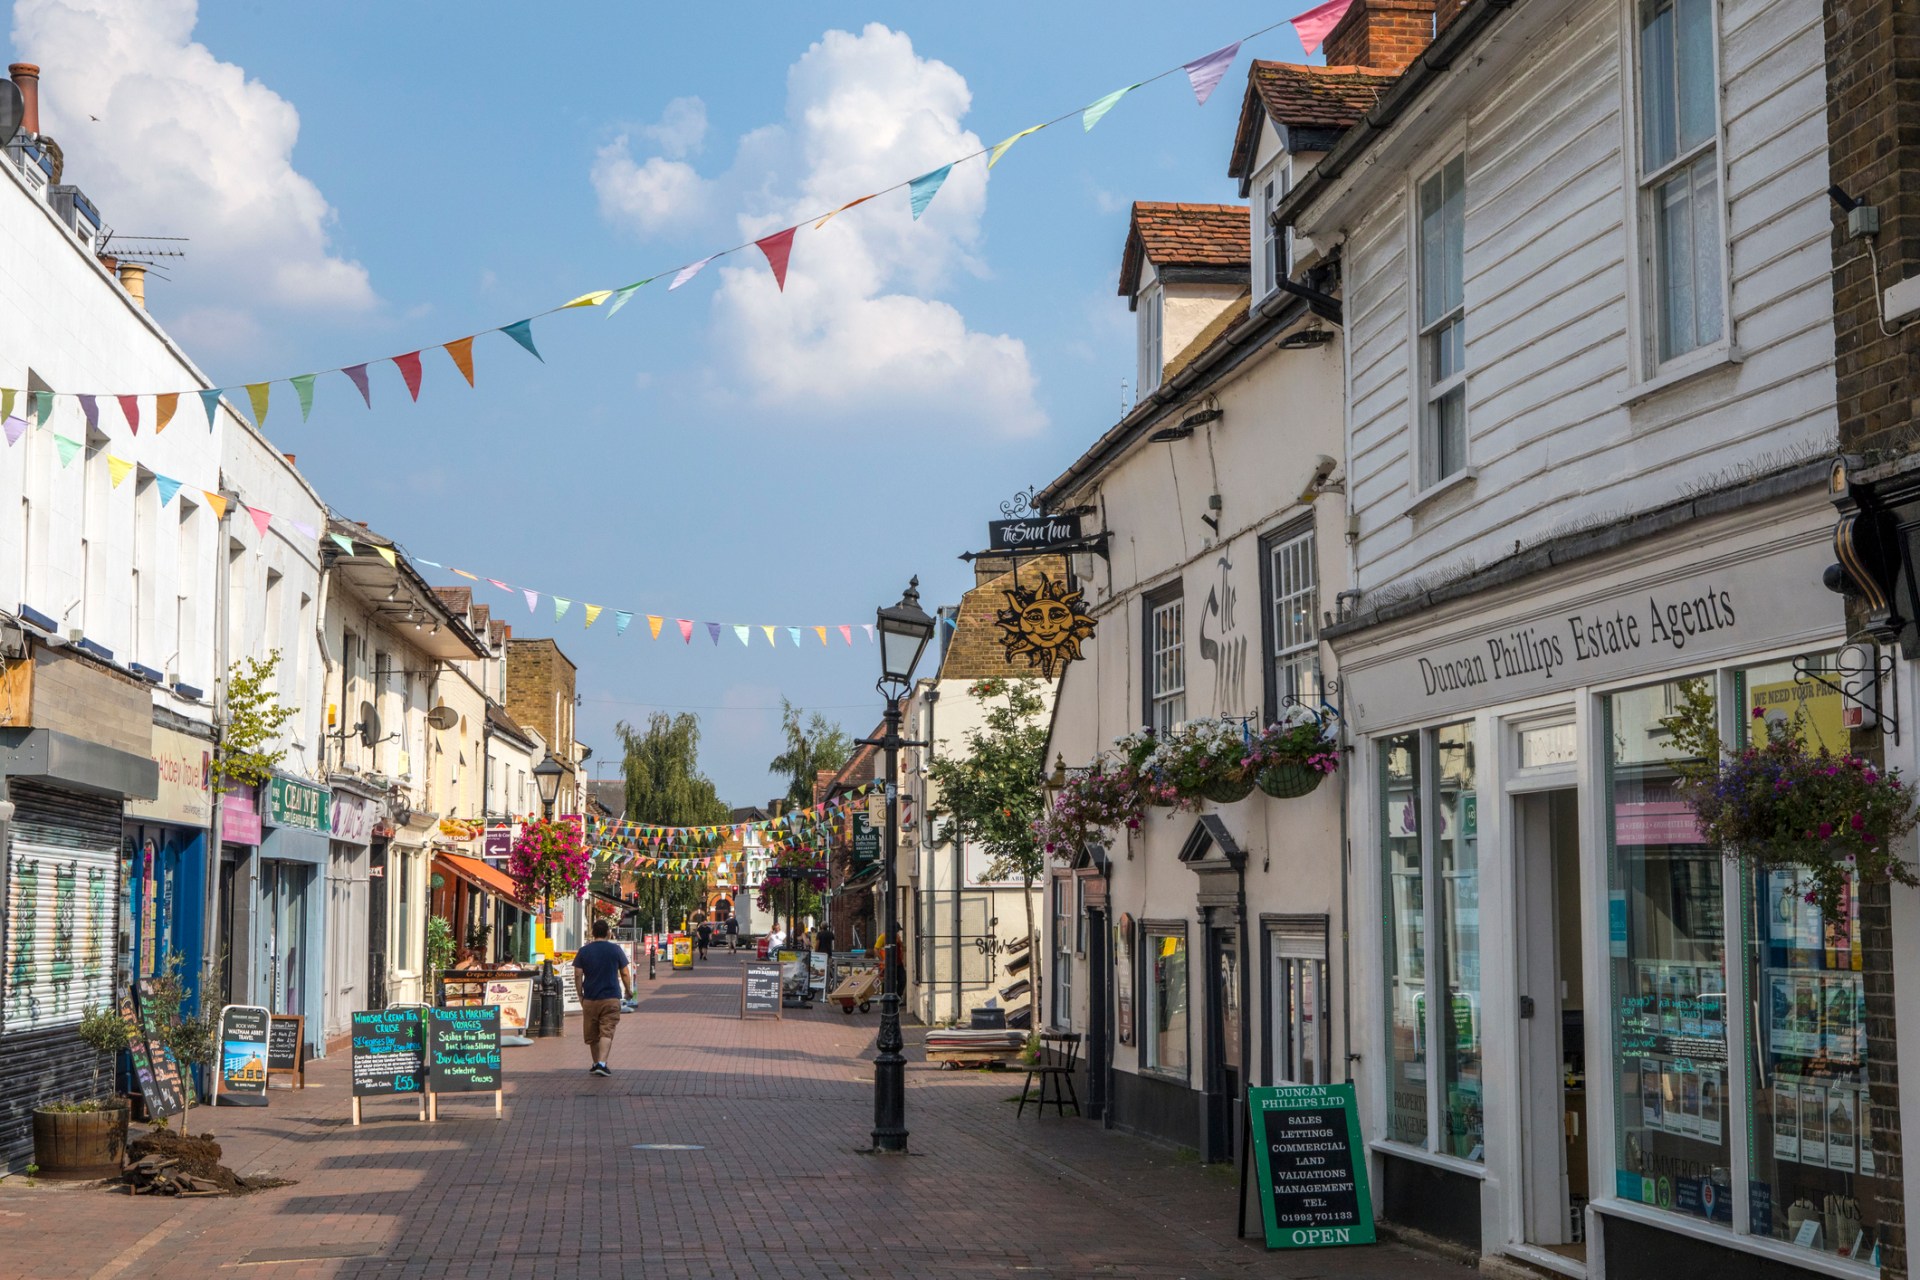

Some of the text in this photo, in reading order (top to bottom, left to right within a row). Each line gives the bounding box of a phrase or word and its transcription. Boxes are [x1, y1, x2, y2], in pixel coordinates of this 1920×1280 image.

[1014, 521, 1044, 544] Sun
[1044, 519, 1071, 544] Inn
[1417, 584, 1736, 696] Duncan Phillips Estate Agents
[1753, 692, 1767, 706] WE
[1768, 688, 1790, 705] NEED
[1816, 680, 1842, 697] PROP
[160, 752, 181, 790] Abbey
[354, 1009, 418, 1023] WINDSOR CREAM TEA
[375, 1023, 400, 1034] CRUISE
[1275, 1087, 1328, 1098] DUNCAN
[1261, 1096, 1345, 1109] PHILLIPS LTD
[1288, 1115, 1323, 1125] SALES
[1280, 1128, 1334, 1139] LETTINGS
[1271, 1141, 1346, 1153] COMMERCIAL
[1295, 1156, 1326, 1166] LAND
[1277, 1169, 1347, 1180] VALUATIONS
[1274, 1182, 1354, 1194] MANAGEMENT
[1302, 1198, 1328, 1208] TEL:
[1281, 1211, 1353, 1222] 01992 701133
[1292, 1227, 1351, 1245] OPEN
